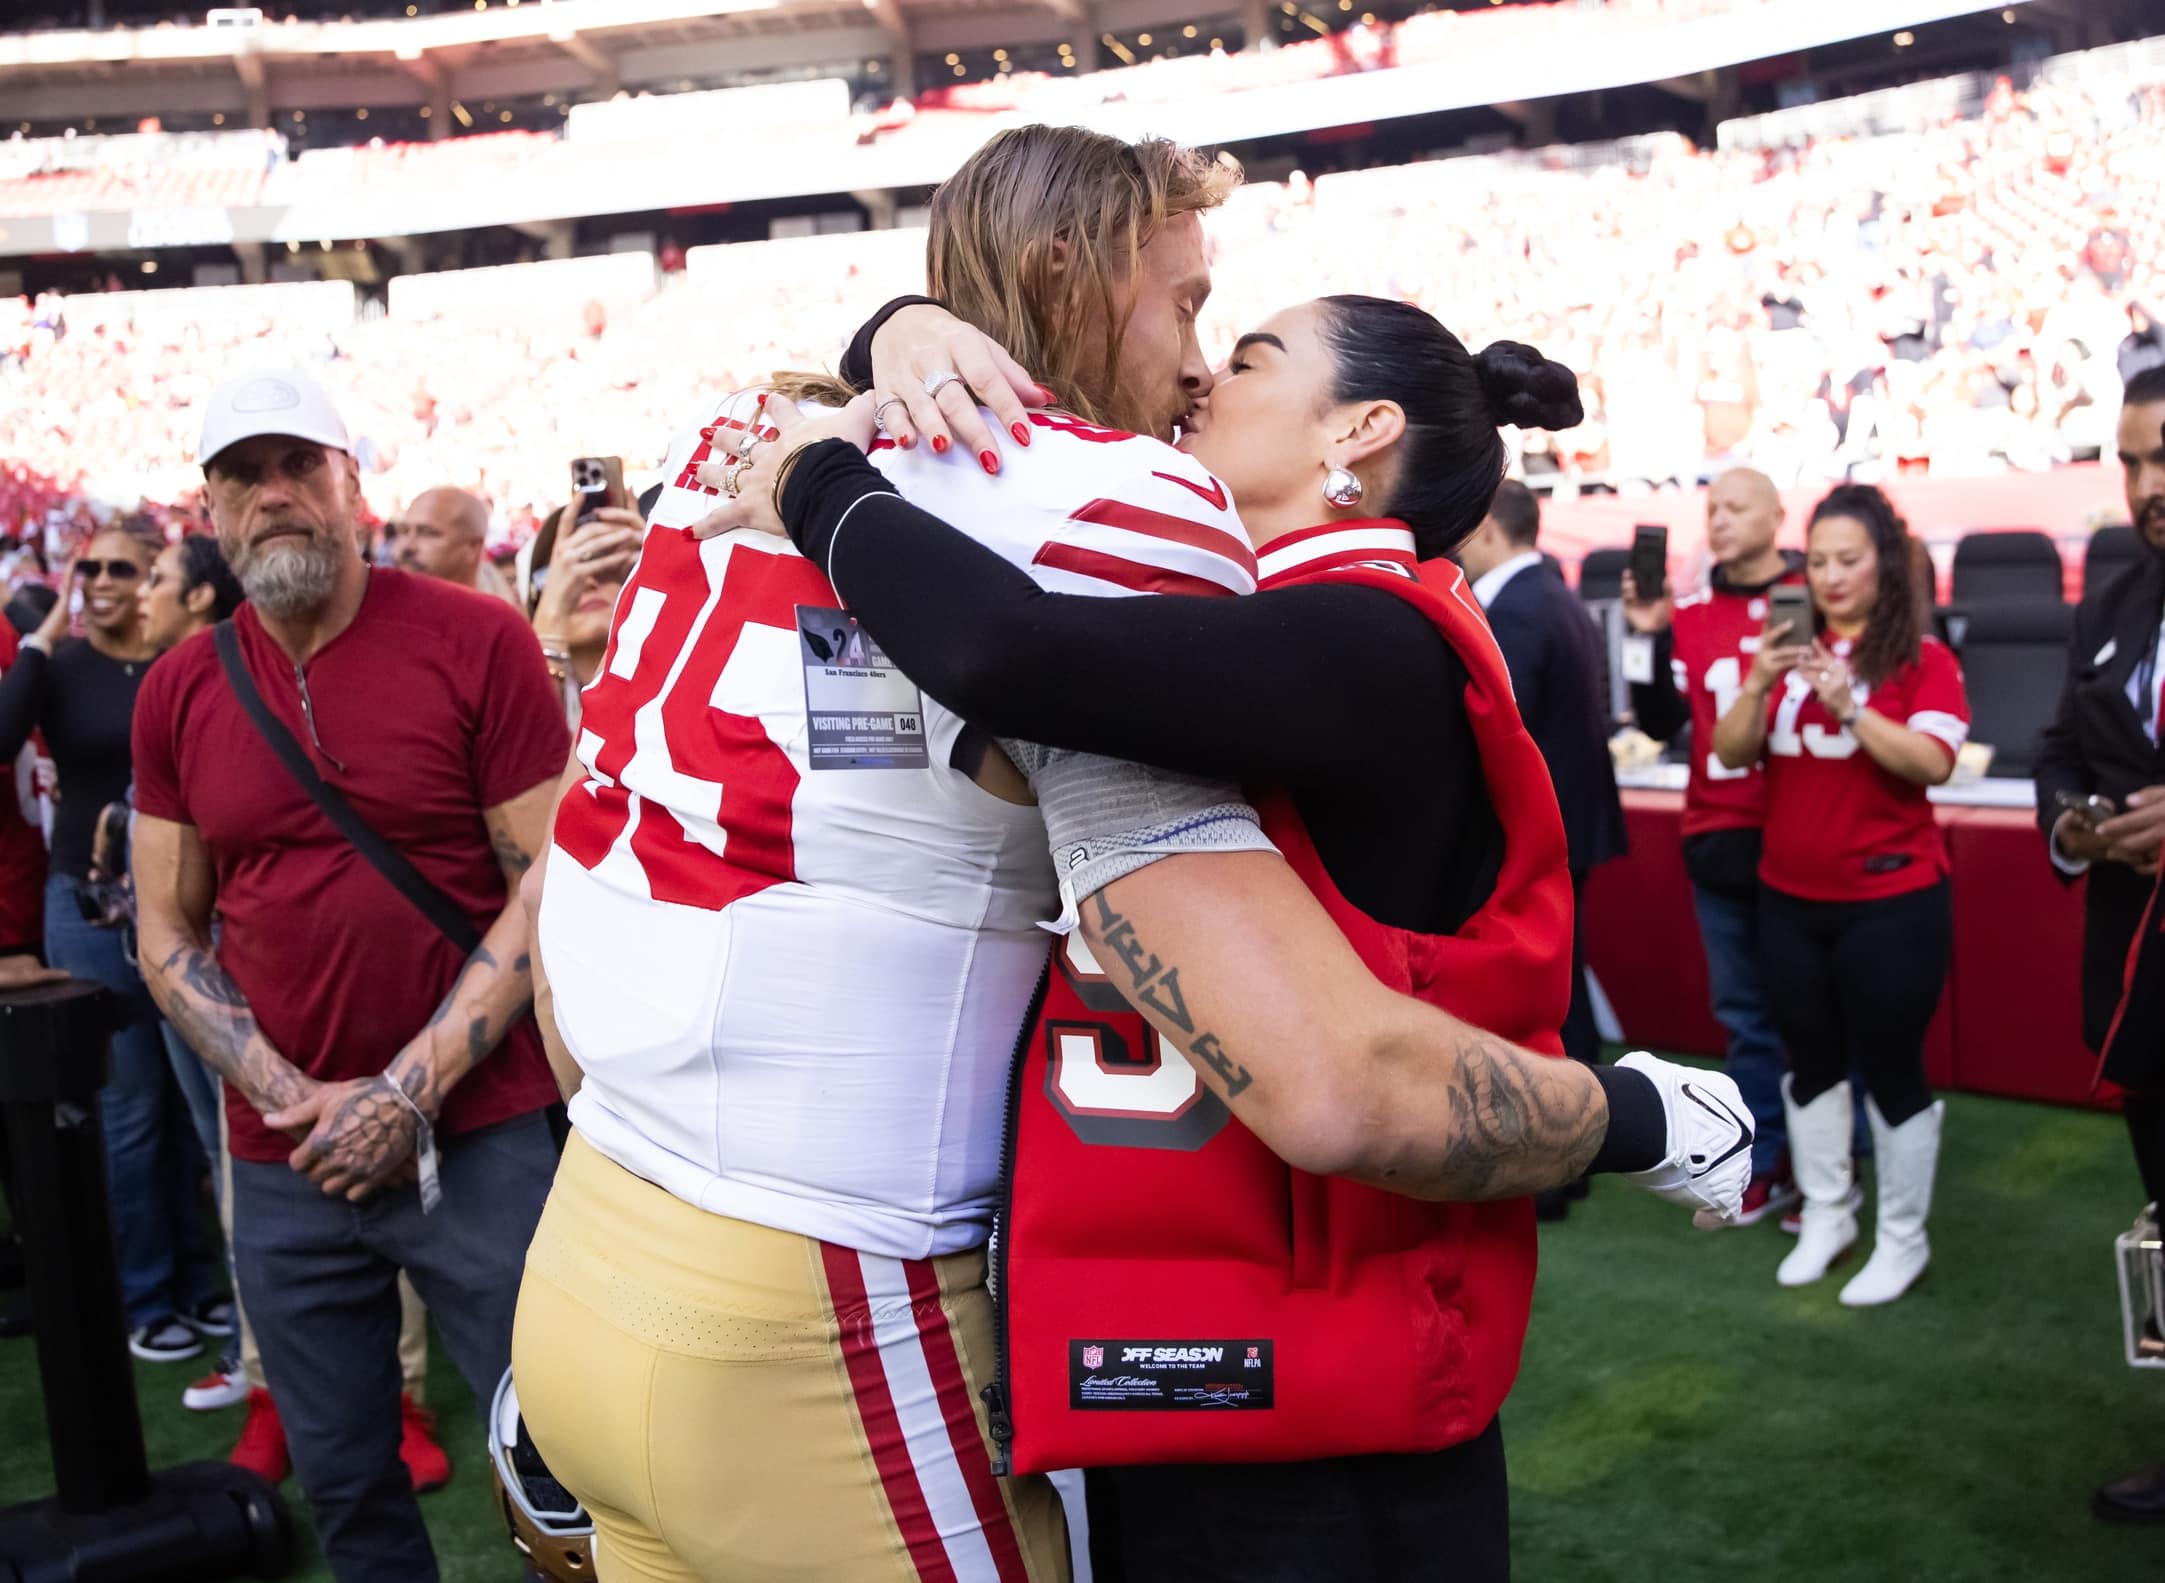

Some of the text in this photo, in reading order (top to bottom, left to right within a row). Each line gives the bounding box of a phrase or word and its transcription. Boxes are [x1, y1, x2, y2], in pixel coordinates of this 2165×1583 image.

[825, 668, 837, 676] San
[838, 669, 868, 678] Francisco
[553, 524, 843, 912] 85
[812, 716, 916, 731] VISITING PRE-GAME 048
[1153, 1347, 1224, 1362] SEASON
